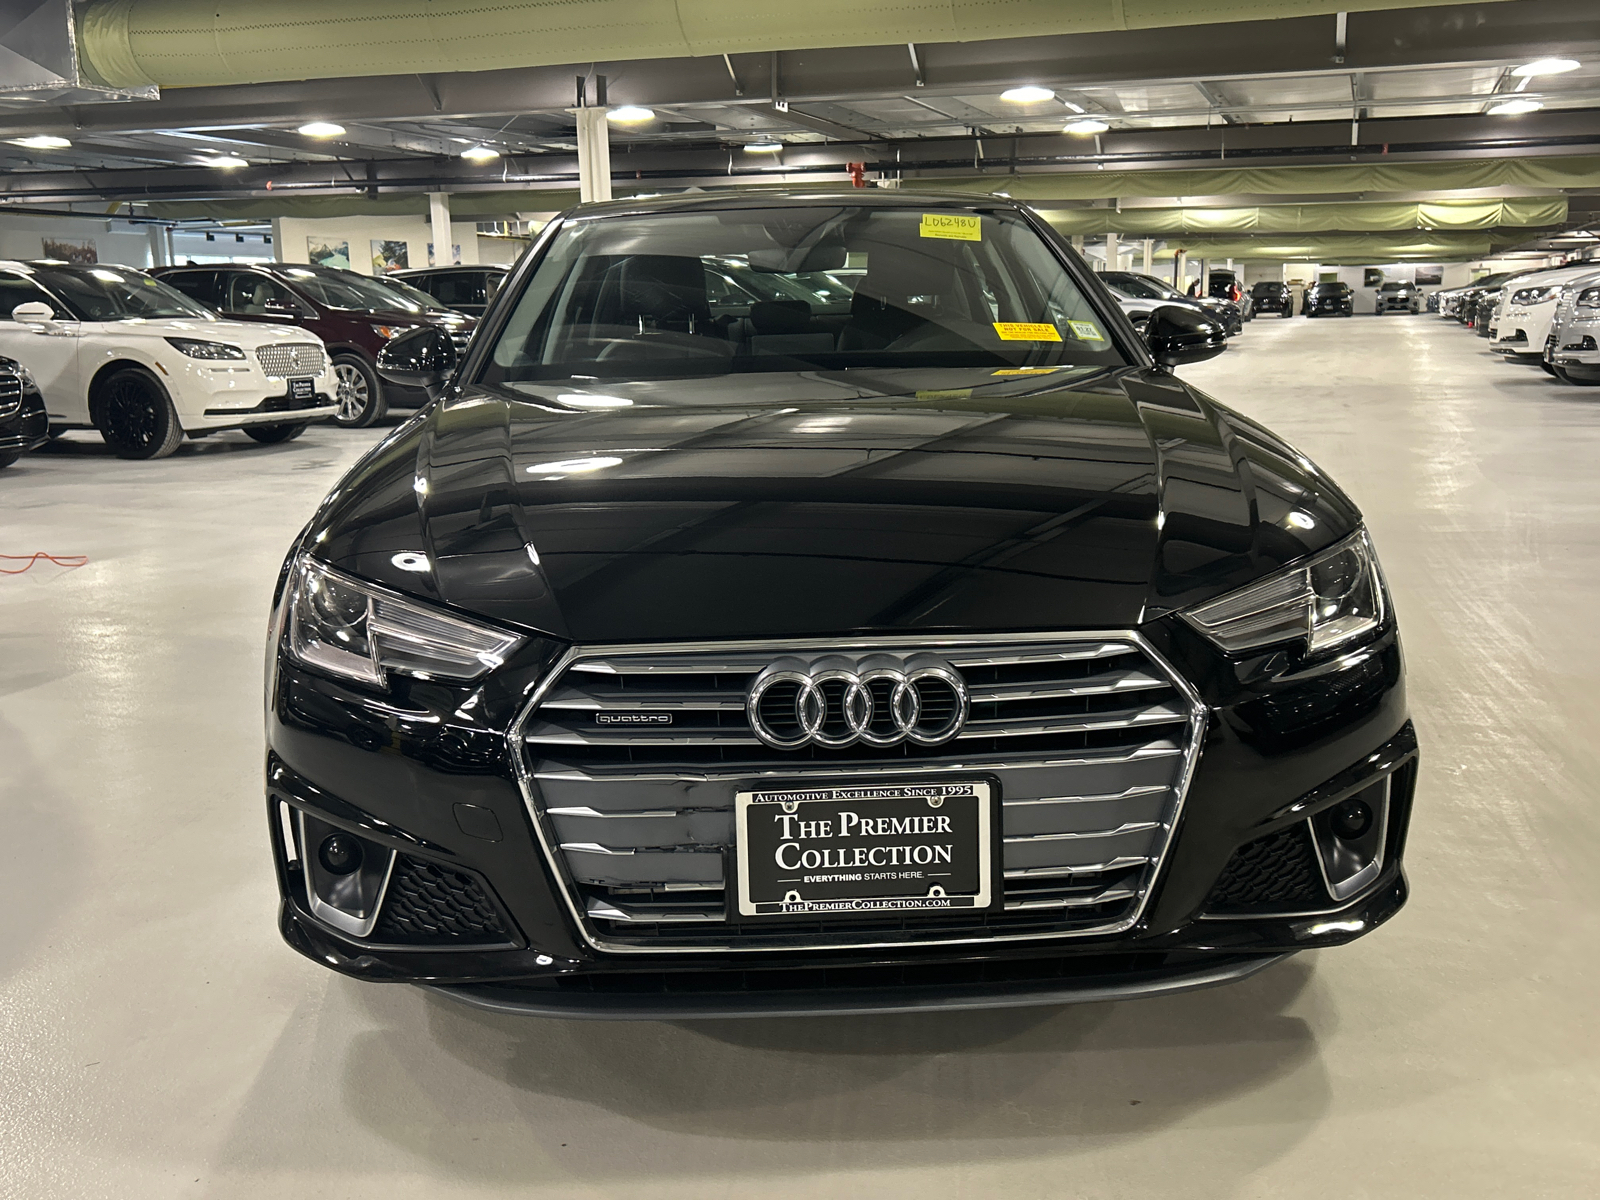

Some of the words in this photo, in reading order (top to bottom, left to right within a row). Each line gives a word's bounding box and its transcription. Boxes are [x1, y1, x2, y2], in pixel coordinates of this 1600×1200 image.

[600, 714, 668, 724] quattro
[755, 792, 828, 802] AUTOMOTIVE
[832, 788, 901, 799] EXCELLENCE
[904, 786, 938, 797] SINCE
[941, 786, 972, 796] 1995
[774, 814, 833, 840] THE
[838, 812, 953, 837] PREMIER
[774, 842, 953, 870] COLLECTION
[804, 874, 862, 883] EVERYTHING
[864, 872, 897, 881] STARTS
[898, 871, 924, 880] HERE.
